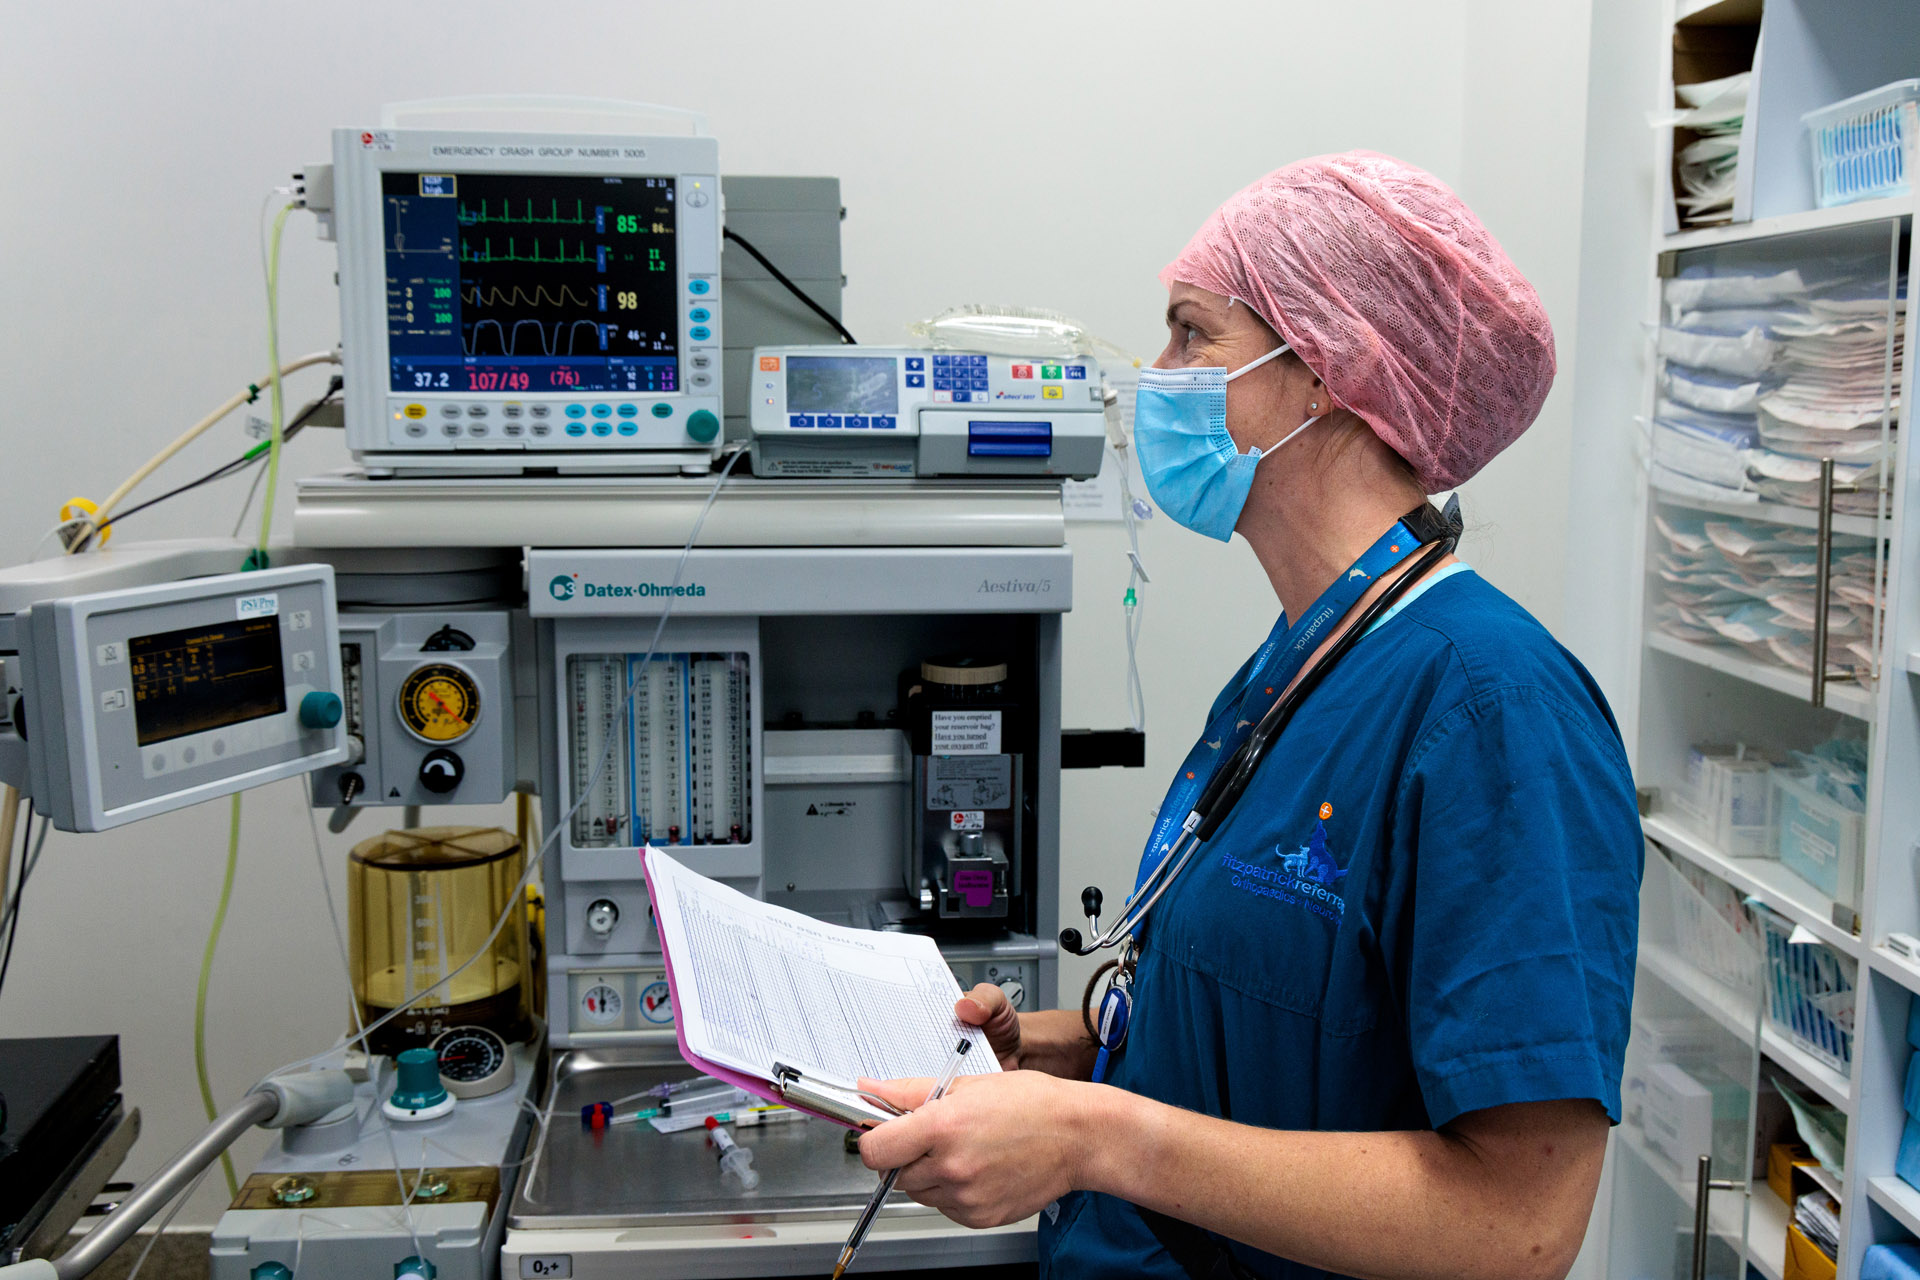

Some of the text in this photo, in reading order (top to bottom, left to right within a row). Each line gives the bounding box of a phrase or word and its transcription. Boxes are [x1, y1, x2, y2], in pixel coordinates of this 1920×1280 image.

[432, 146, 495, 156] EMERGENCY
[500, 147, 534, 157] CRASH
[538, 147, 575, 158] GROUP
[577, 148, 620, 158] NUMBER
[617, 214, 638, 234] 85
[617, 291, 638, 310] 98
[414, 372, 450, 388] 37.2
[468, 370, 580, 391] 107/49 (76)
[978, 578, 1052, 596] Aestiva/5
[966, 713, 992, 722] emptied
[951, 722, 979, 730] reservoir
[980, 722, 995, 731] bag?
[966, 732, 987, 740] turned
